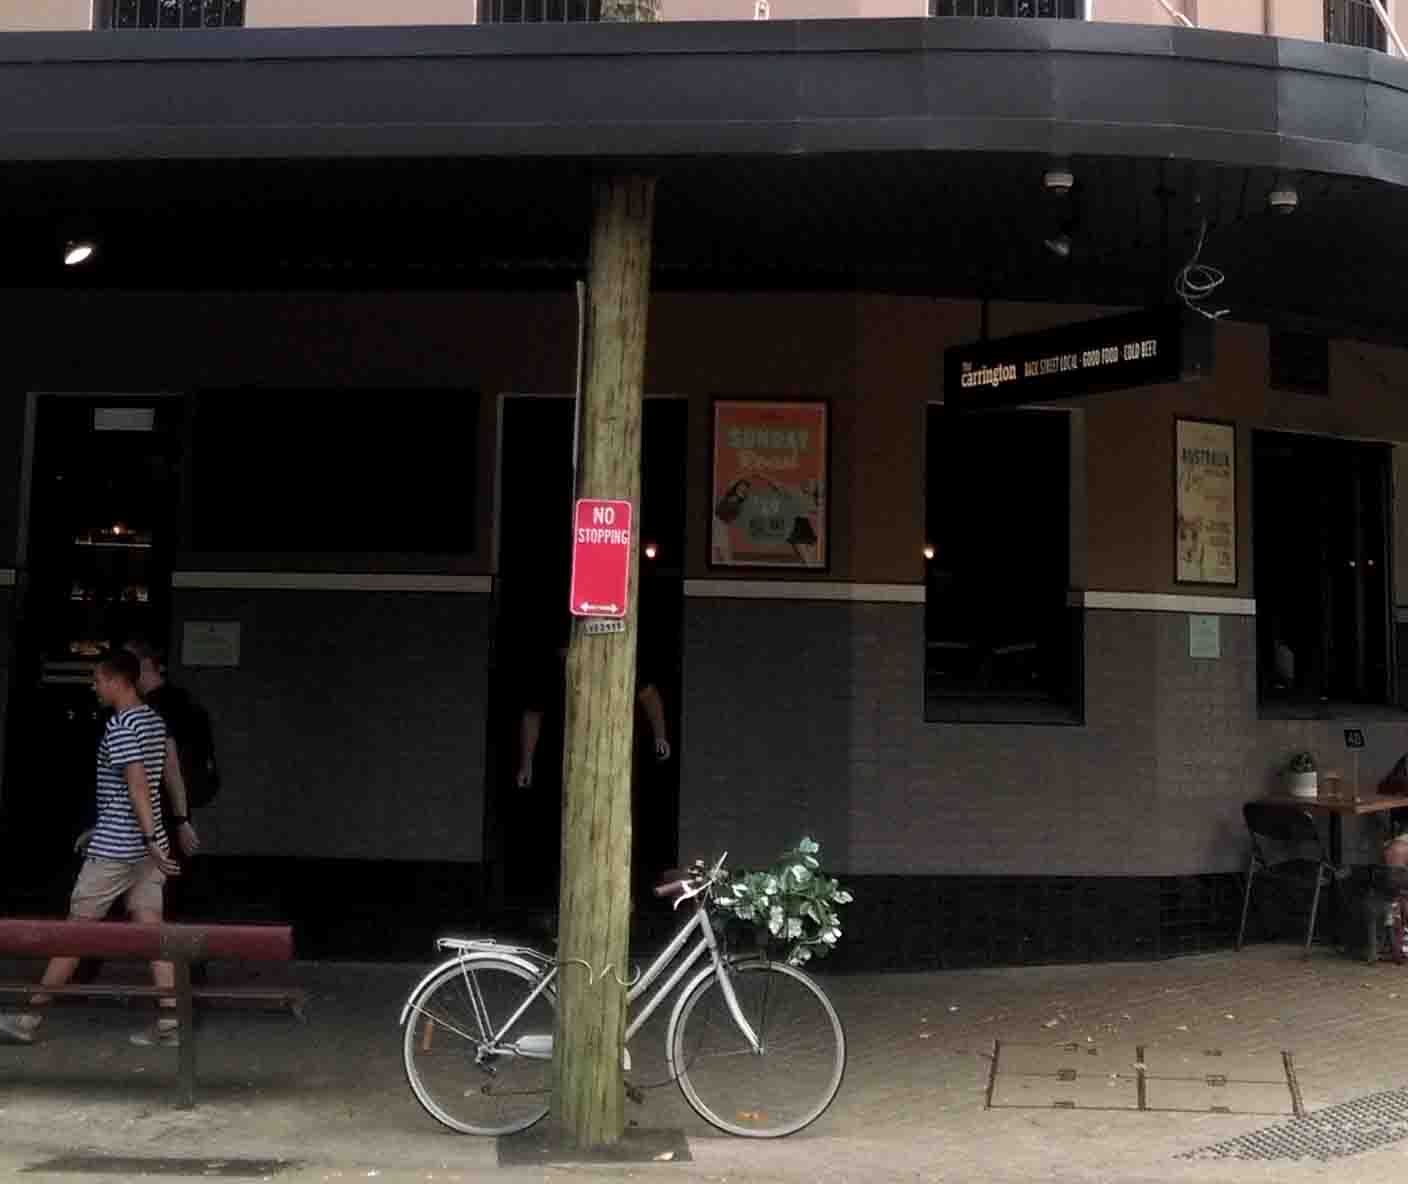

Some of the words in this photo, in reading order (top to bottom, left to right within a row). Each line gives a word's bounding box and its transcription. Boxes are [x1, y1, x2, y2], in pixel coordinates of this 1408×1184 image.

[961, 363, 1016, 388] carrington
[728, 426, 810, 450] SUNDAY
[592, 506, 615, 525] NO
[578, 527, 628, 545] STOPPING
